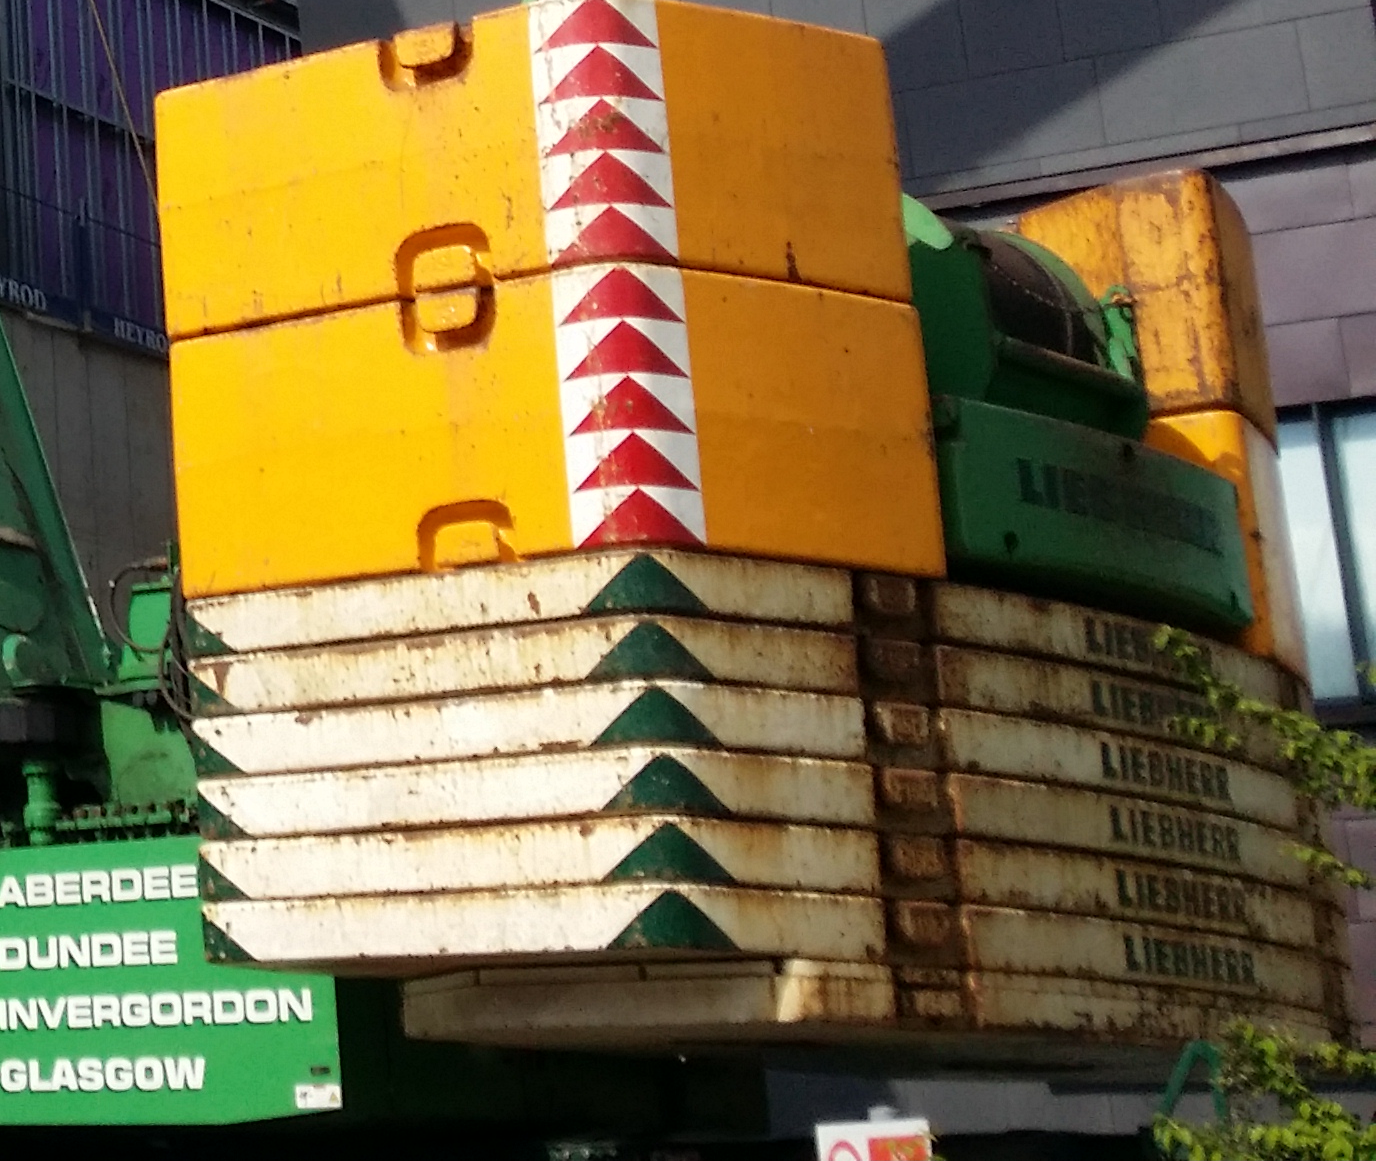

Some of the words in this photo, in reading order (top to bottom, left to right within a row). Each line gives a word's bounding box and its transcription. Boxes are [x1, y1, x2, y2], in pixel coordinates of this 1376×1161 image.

[115, 319, 167, 353] HEYRO
[1110, 806, 1241, 861] LIEBHERR
[0, 1056, 205, 1092] GLASGOW
